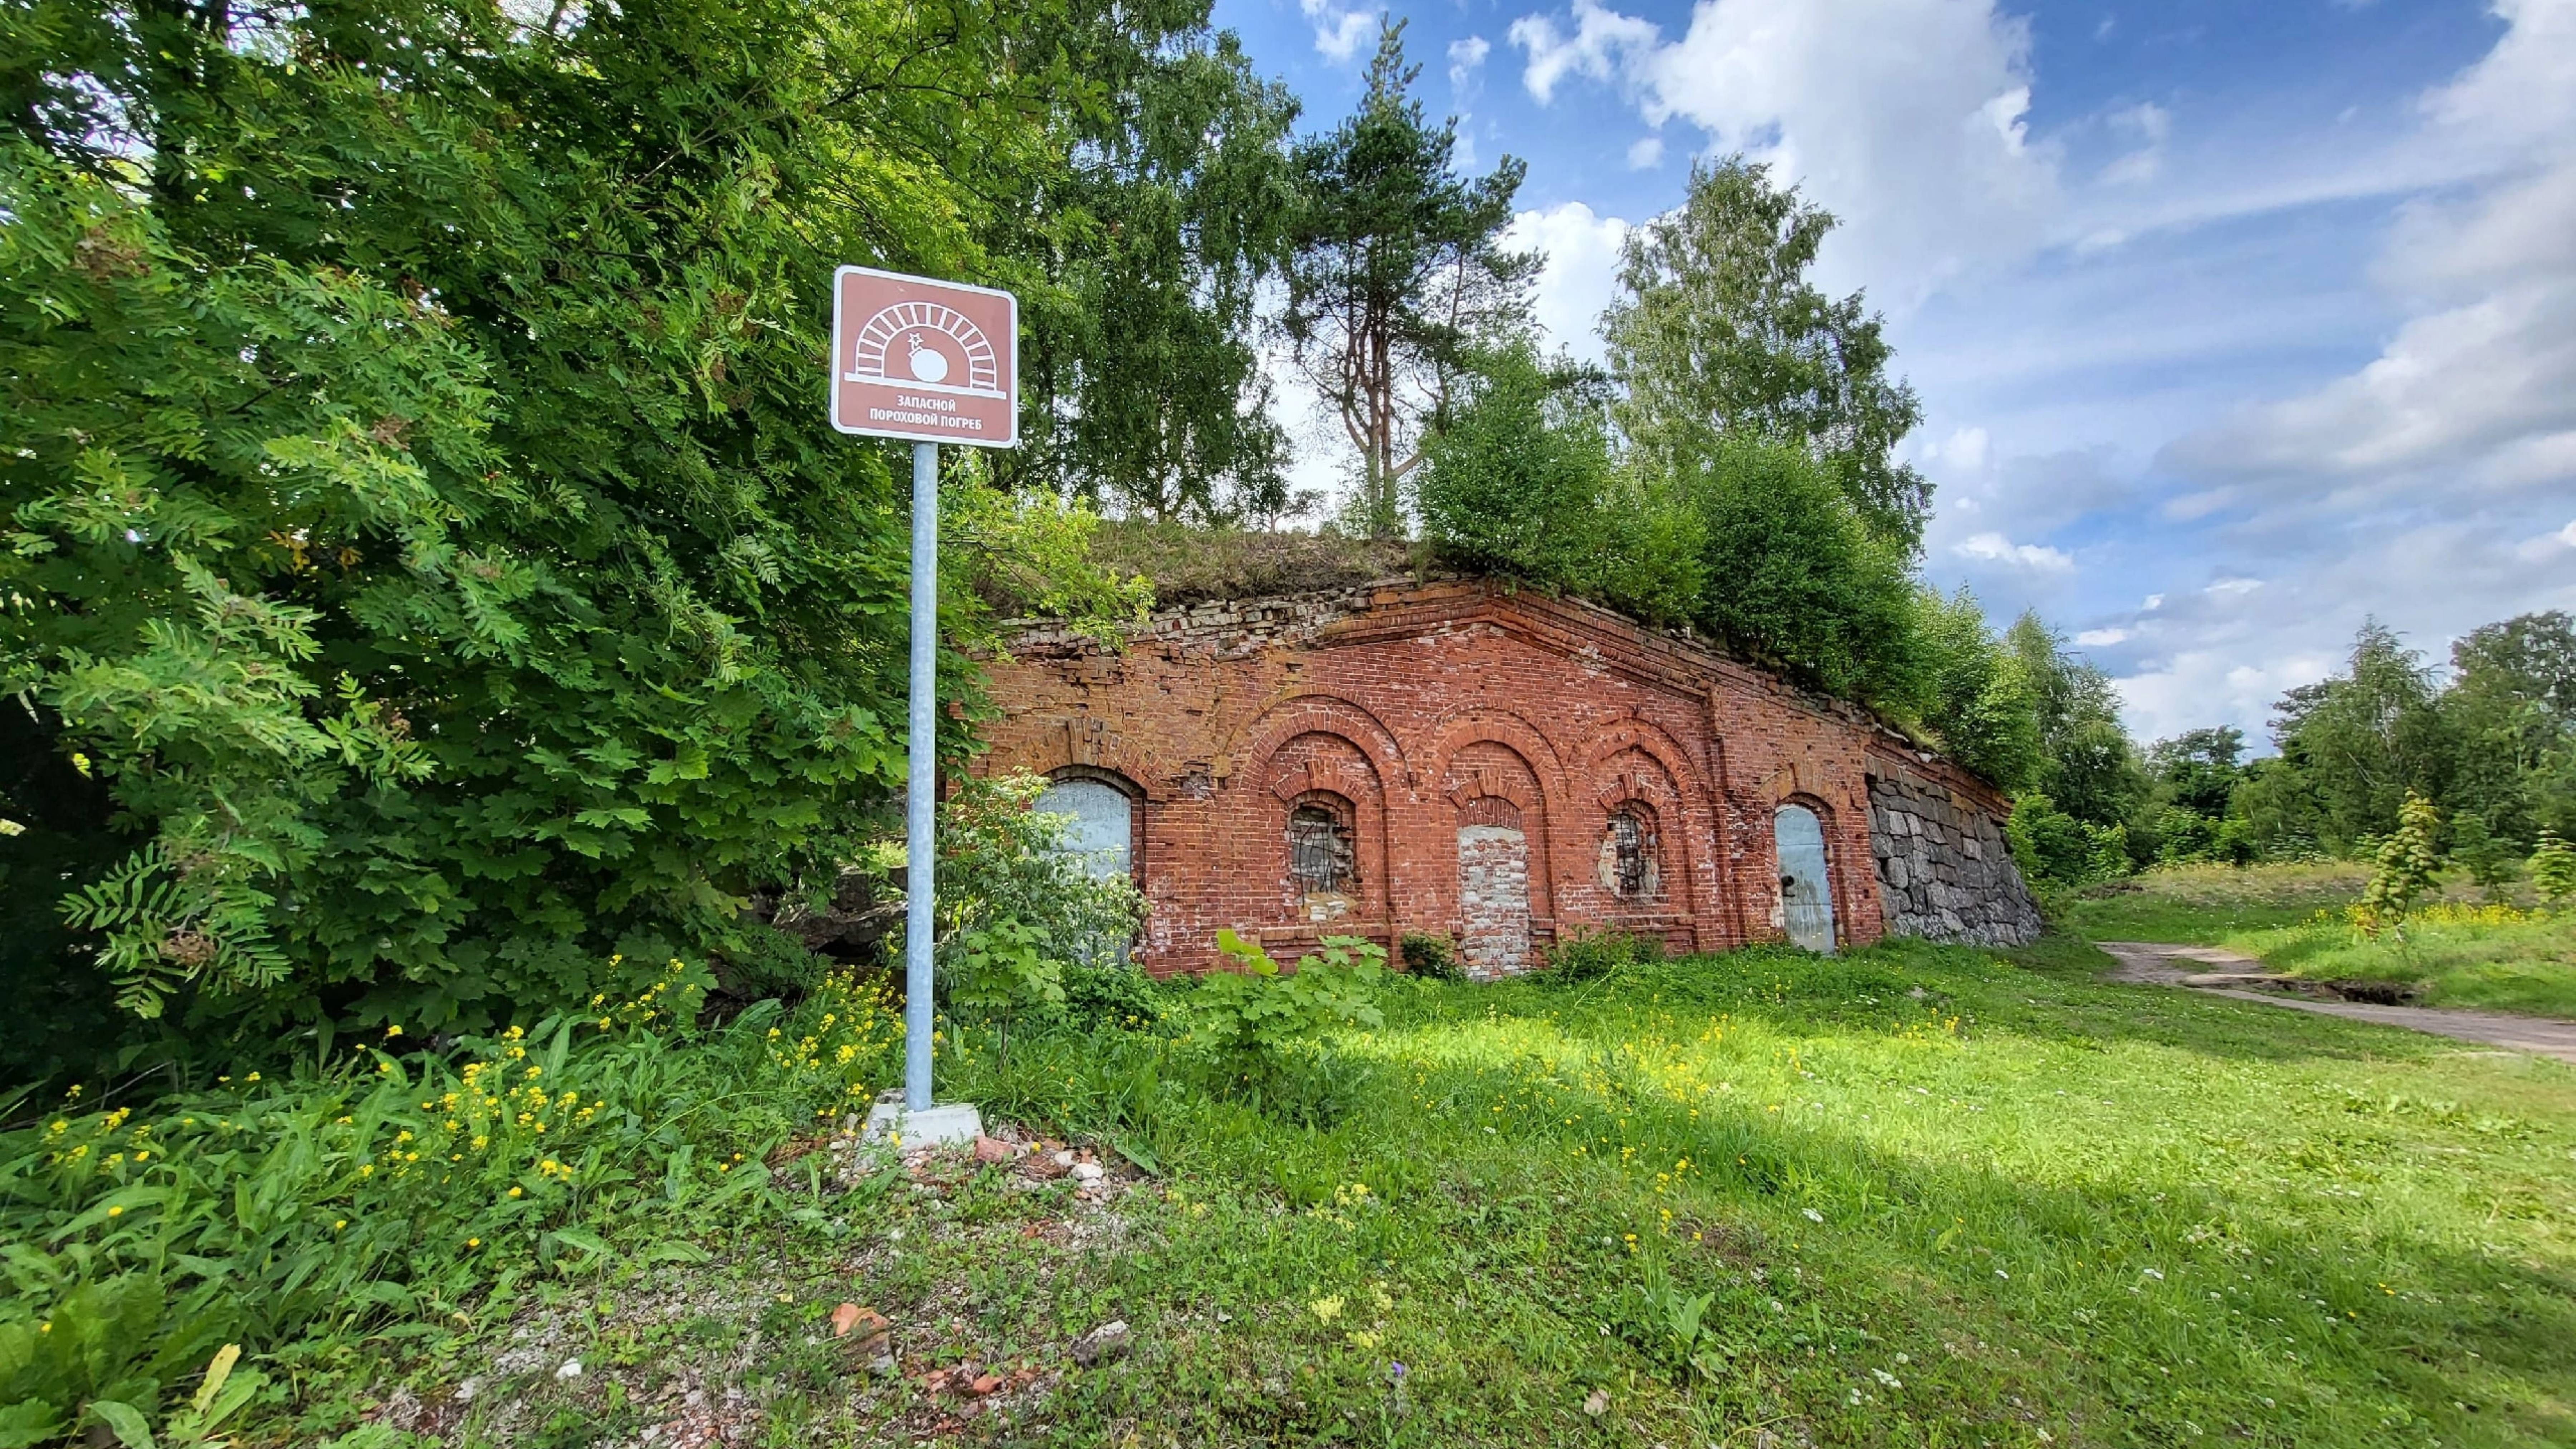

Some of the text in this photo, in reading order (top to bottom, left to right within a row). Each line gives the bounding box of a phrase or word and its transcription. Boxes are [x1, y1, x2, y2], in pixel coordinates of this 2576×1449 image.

[897, 395, 956, 411] ЗАПАСНОЙ
[870, 408, 982, 430] ПОРОХОВОЙ ПОГРЕБ
